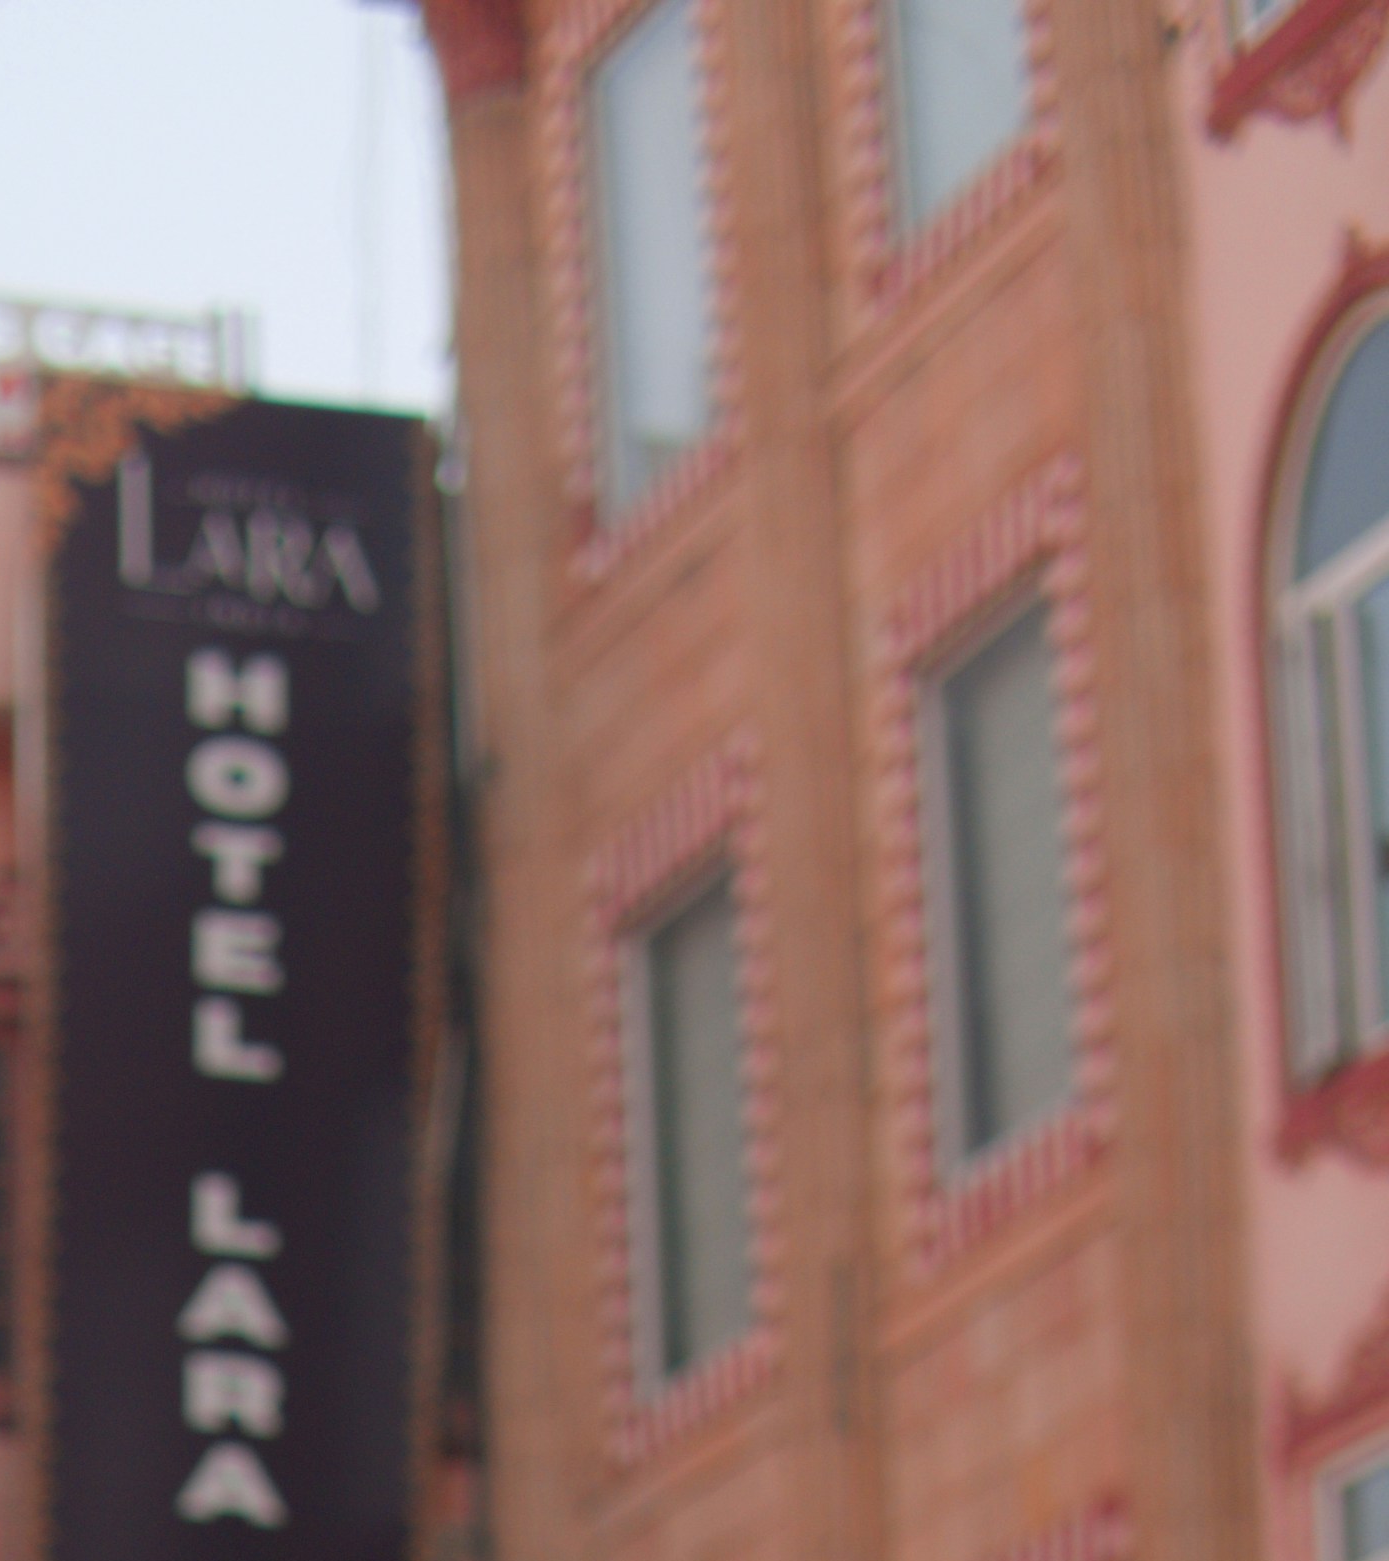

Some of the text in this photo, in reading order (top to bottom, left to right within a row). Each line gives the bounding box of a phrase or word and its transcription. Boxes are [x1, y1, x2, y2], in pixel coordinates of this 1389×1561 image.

[117, 446, 381, 614] LARA
[186, 644, 289, 1083] HOTEL
[175, 1172, 289, 1528] LARA
